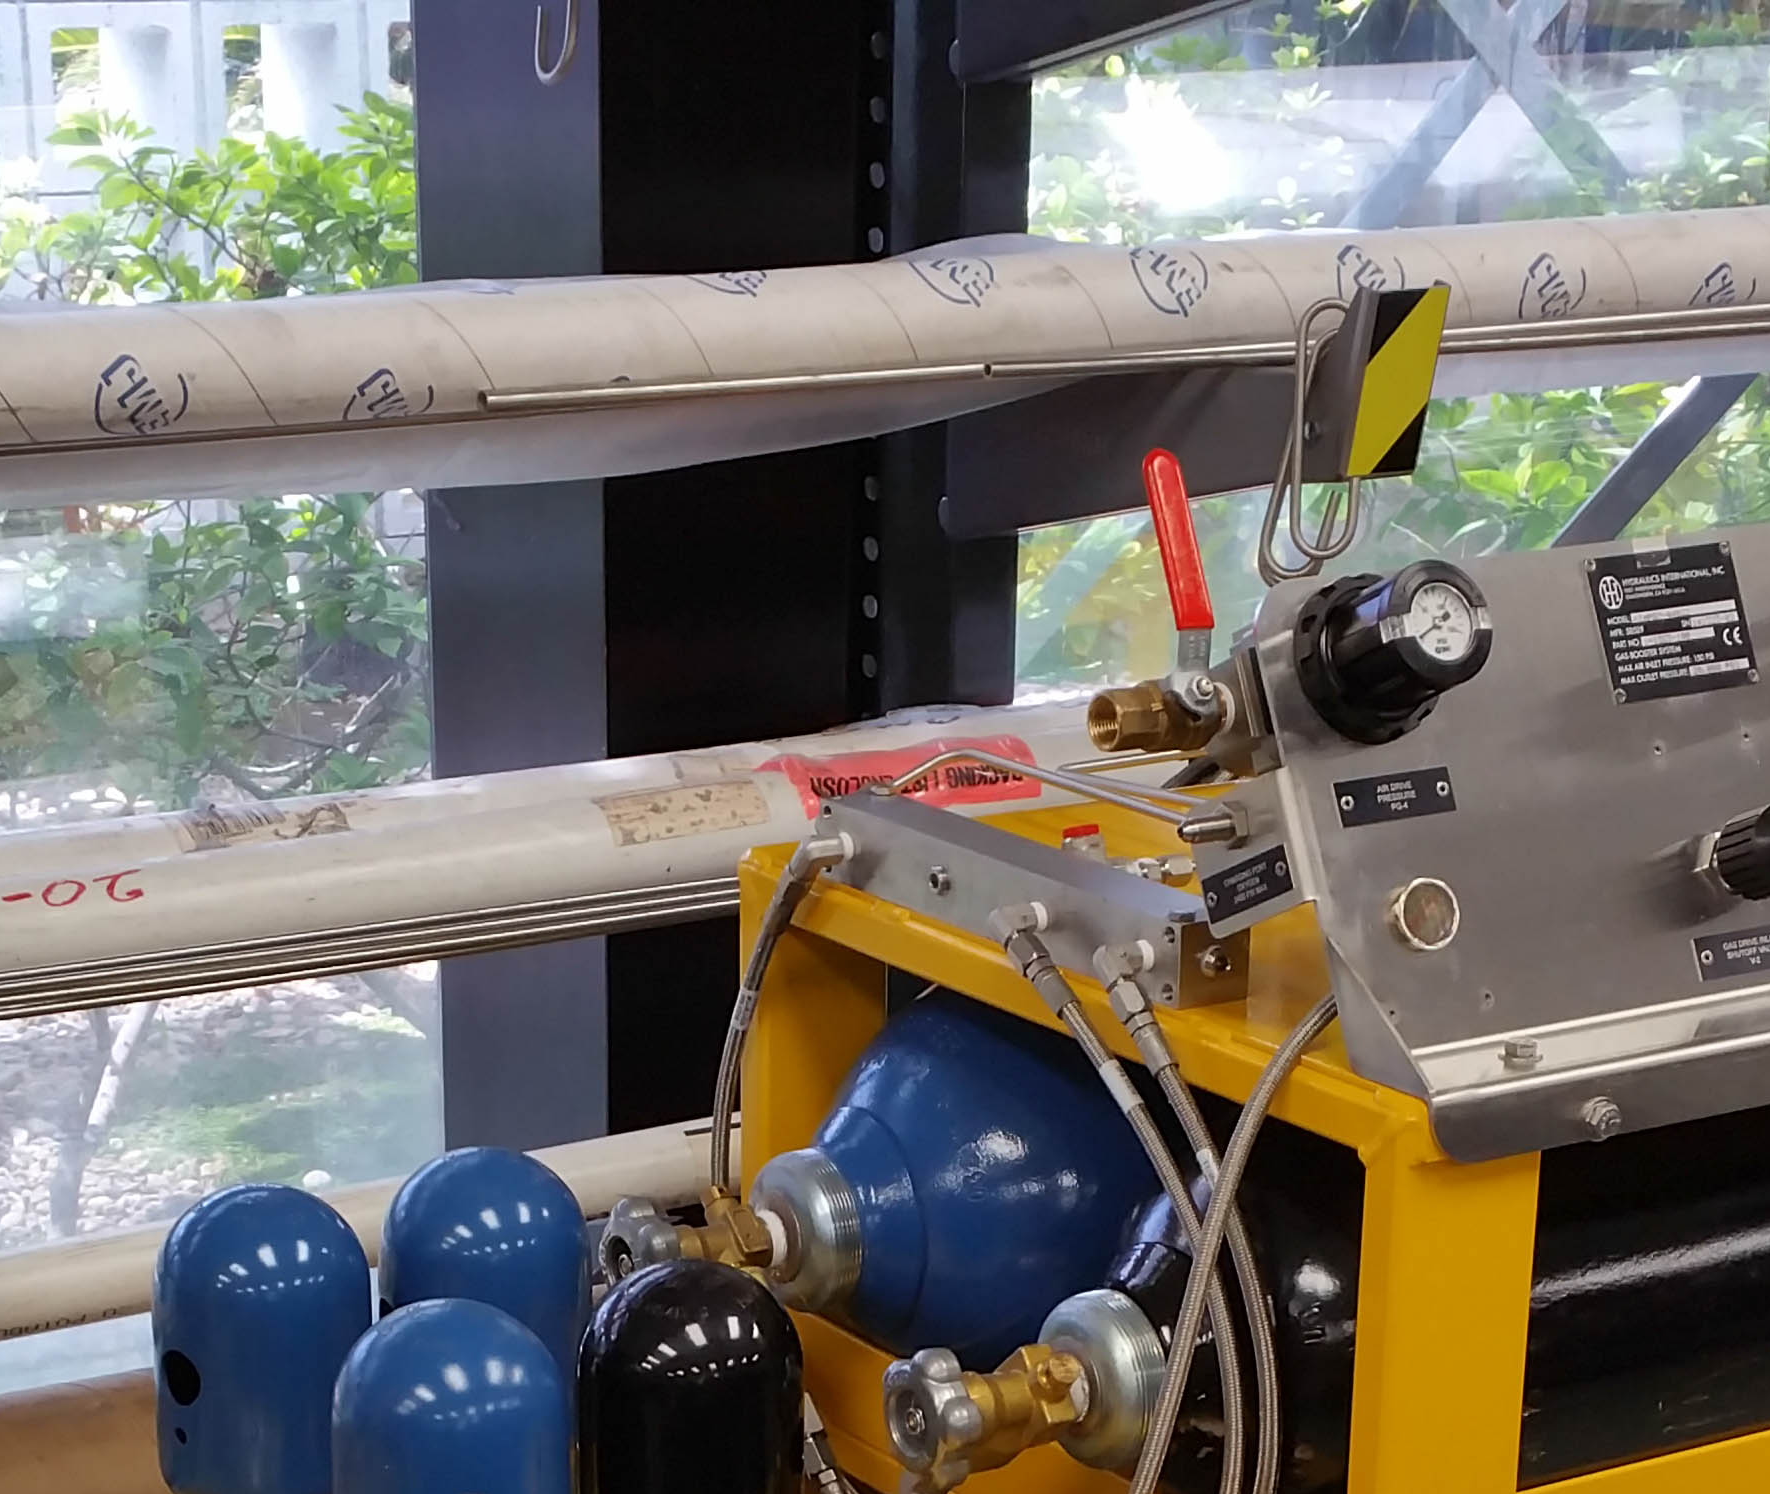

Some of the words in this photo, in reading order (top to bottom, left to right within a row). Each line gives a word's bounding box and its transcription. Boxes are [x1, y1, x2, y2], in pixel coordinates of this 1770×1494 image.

[1377, 783, 1390, 793] AIR
[1390, 780, 1412, 791] DRIVE
[1377, 790, 1417, 803] PRESSURE
